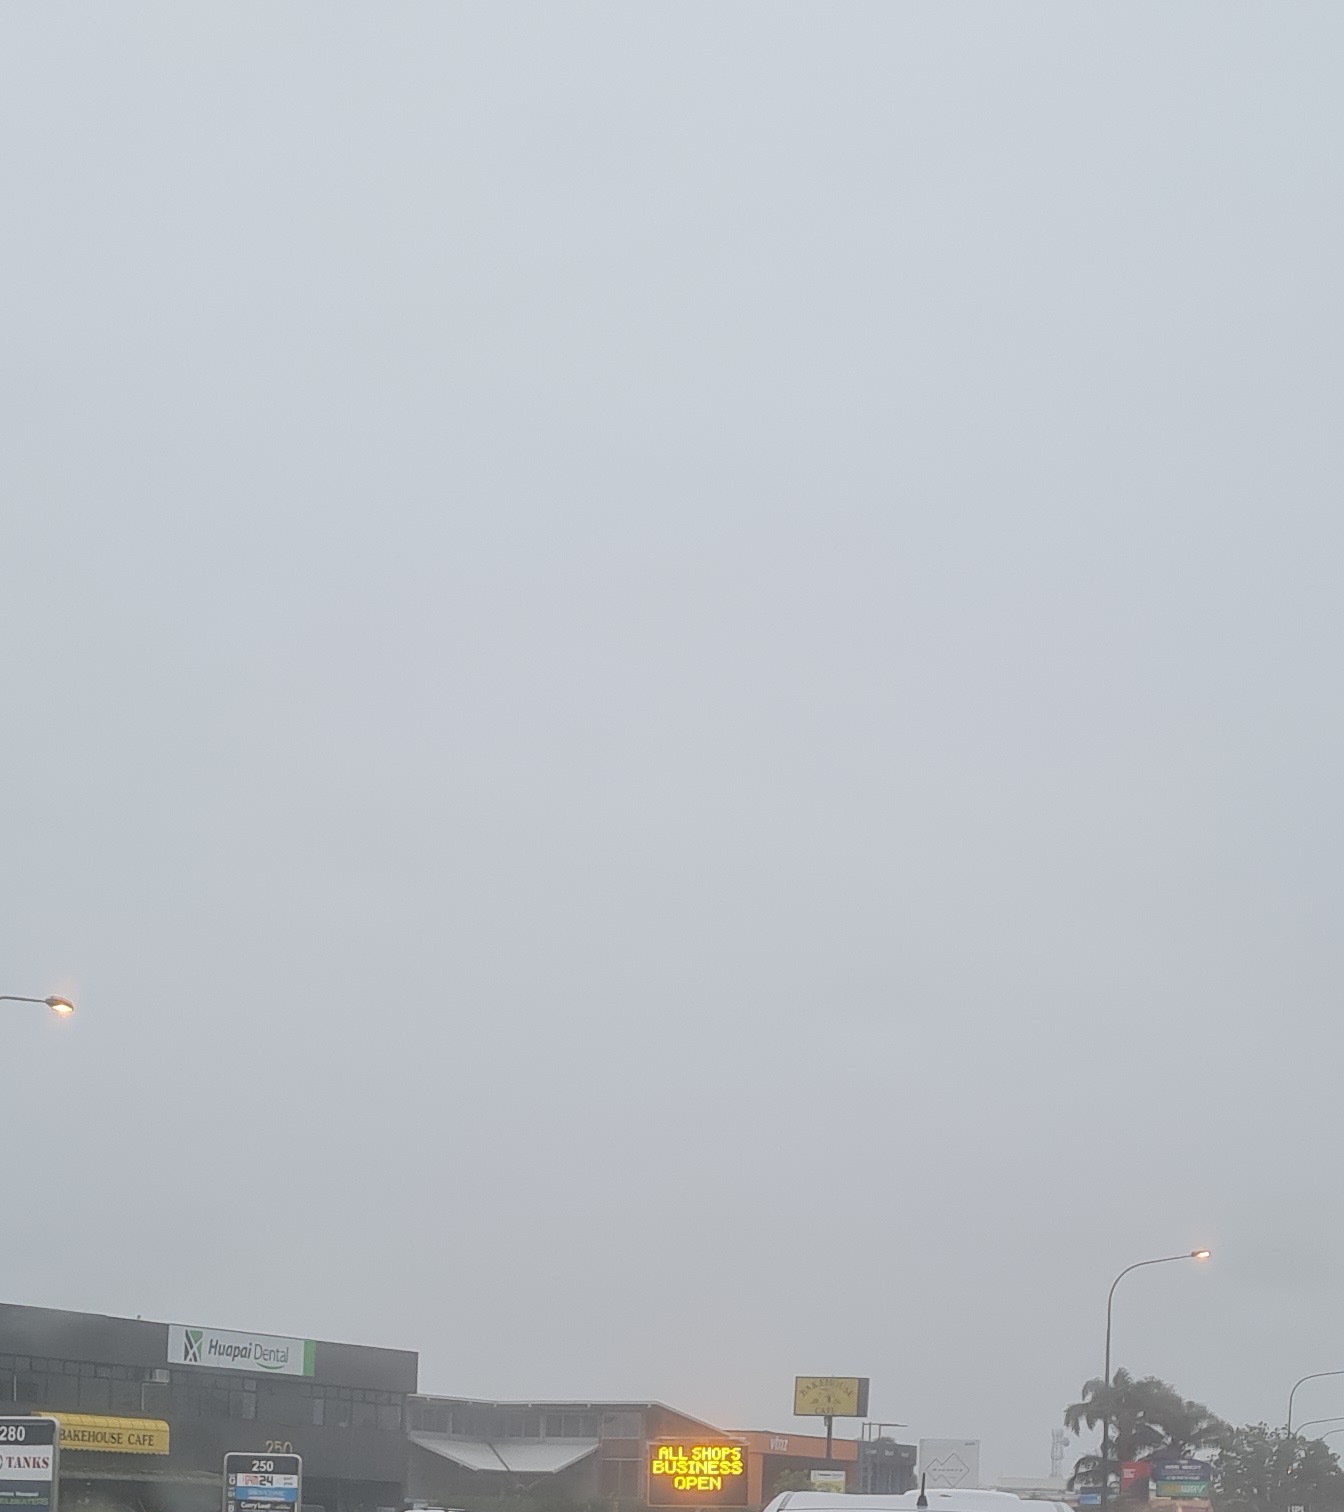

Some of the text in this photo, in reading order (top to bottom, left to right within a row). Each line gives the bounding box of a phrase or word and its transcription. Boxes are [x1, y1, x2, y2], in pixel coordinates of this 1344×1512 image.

[208, 1338, 290, 1364] Huapai Dental
[59, 1428, 155, 1447] BAKEHOUSE CAFE
[658, 1446, 742, 1461] ALL SHOPS
[6, 1456, 50, 1469] TANKS
[251, 1460, 274, 1472] 250
[652, 1460, 744, 1475] BUSINESS
[259, 1475, 274, 1487] 24
[673, 1476, 722, 1491] OPEN
